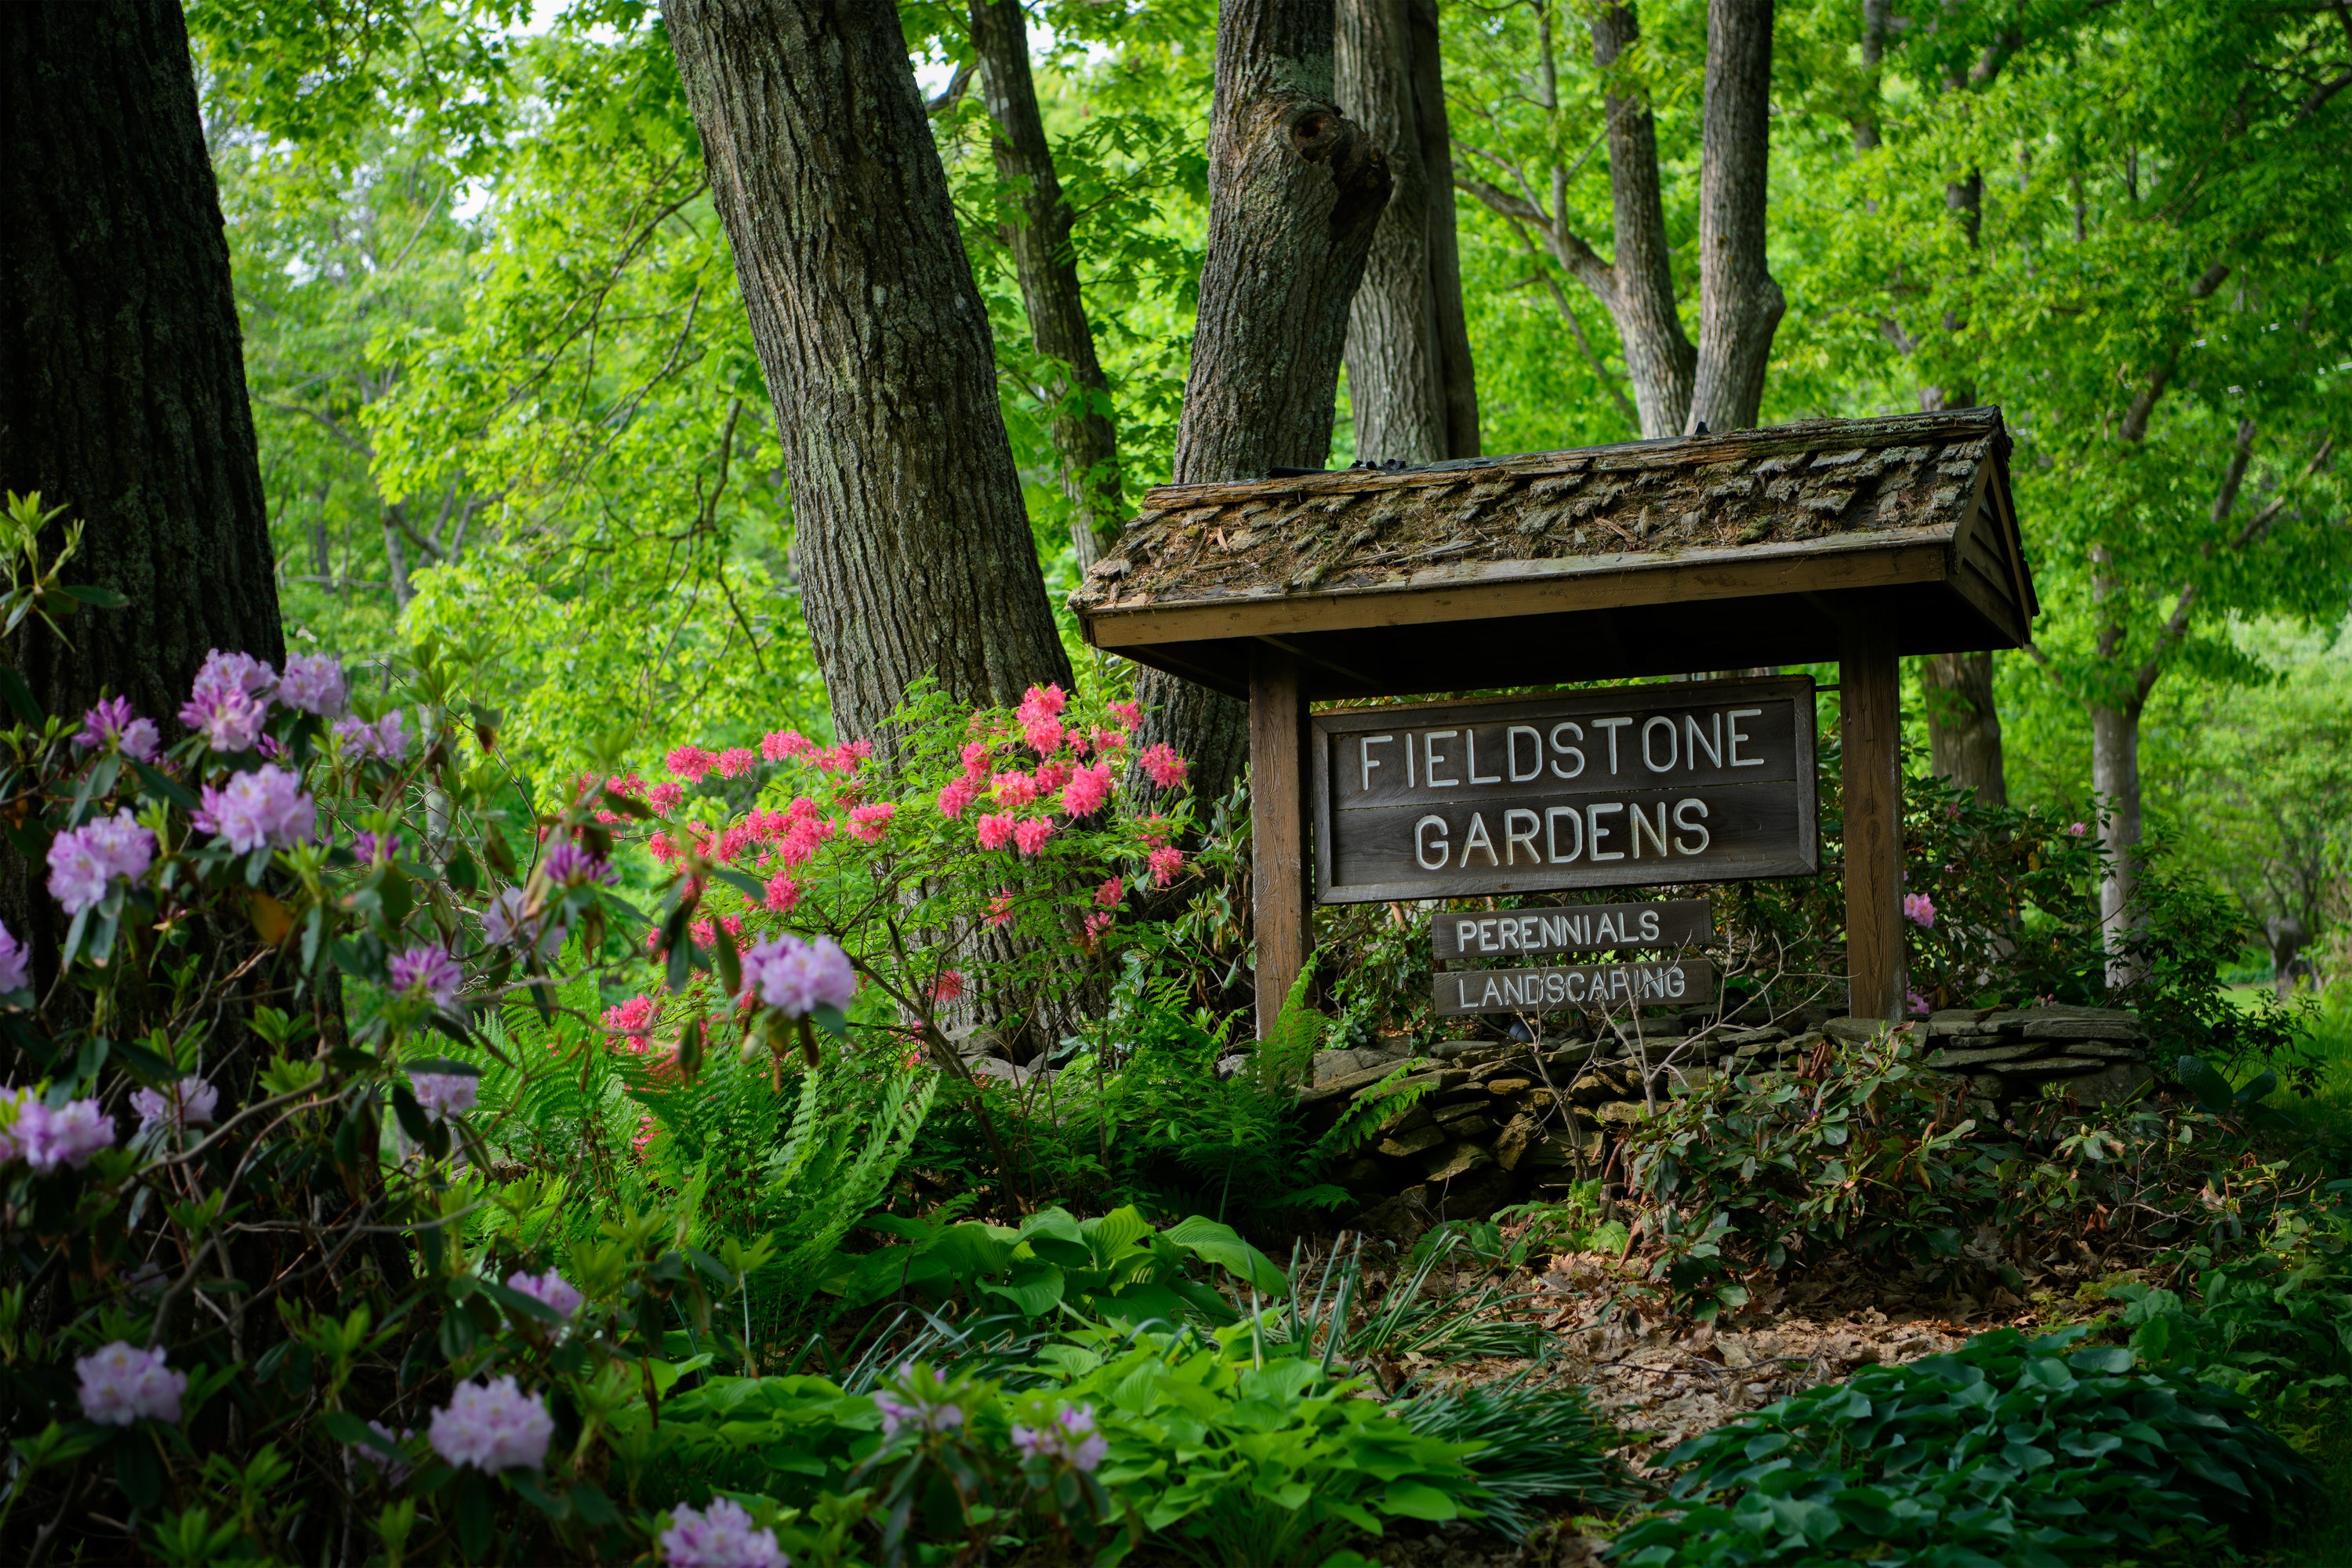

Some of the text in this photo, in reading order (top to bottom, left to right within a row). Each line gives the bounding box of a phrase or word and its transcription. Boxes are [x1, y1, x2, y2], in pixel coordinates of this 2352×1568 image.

[1360, 709, 1765, 790] FIELDSTONE
[1414, 798, 1710, 870] GARDENS
[1456, 910, 1660, 952] PERENNIALS
[1459, 967, 1685, 1008] LANDSCAPING
